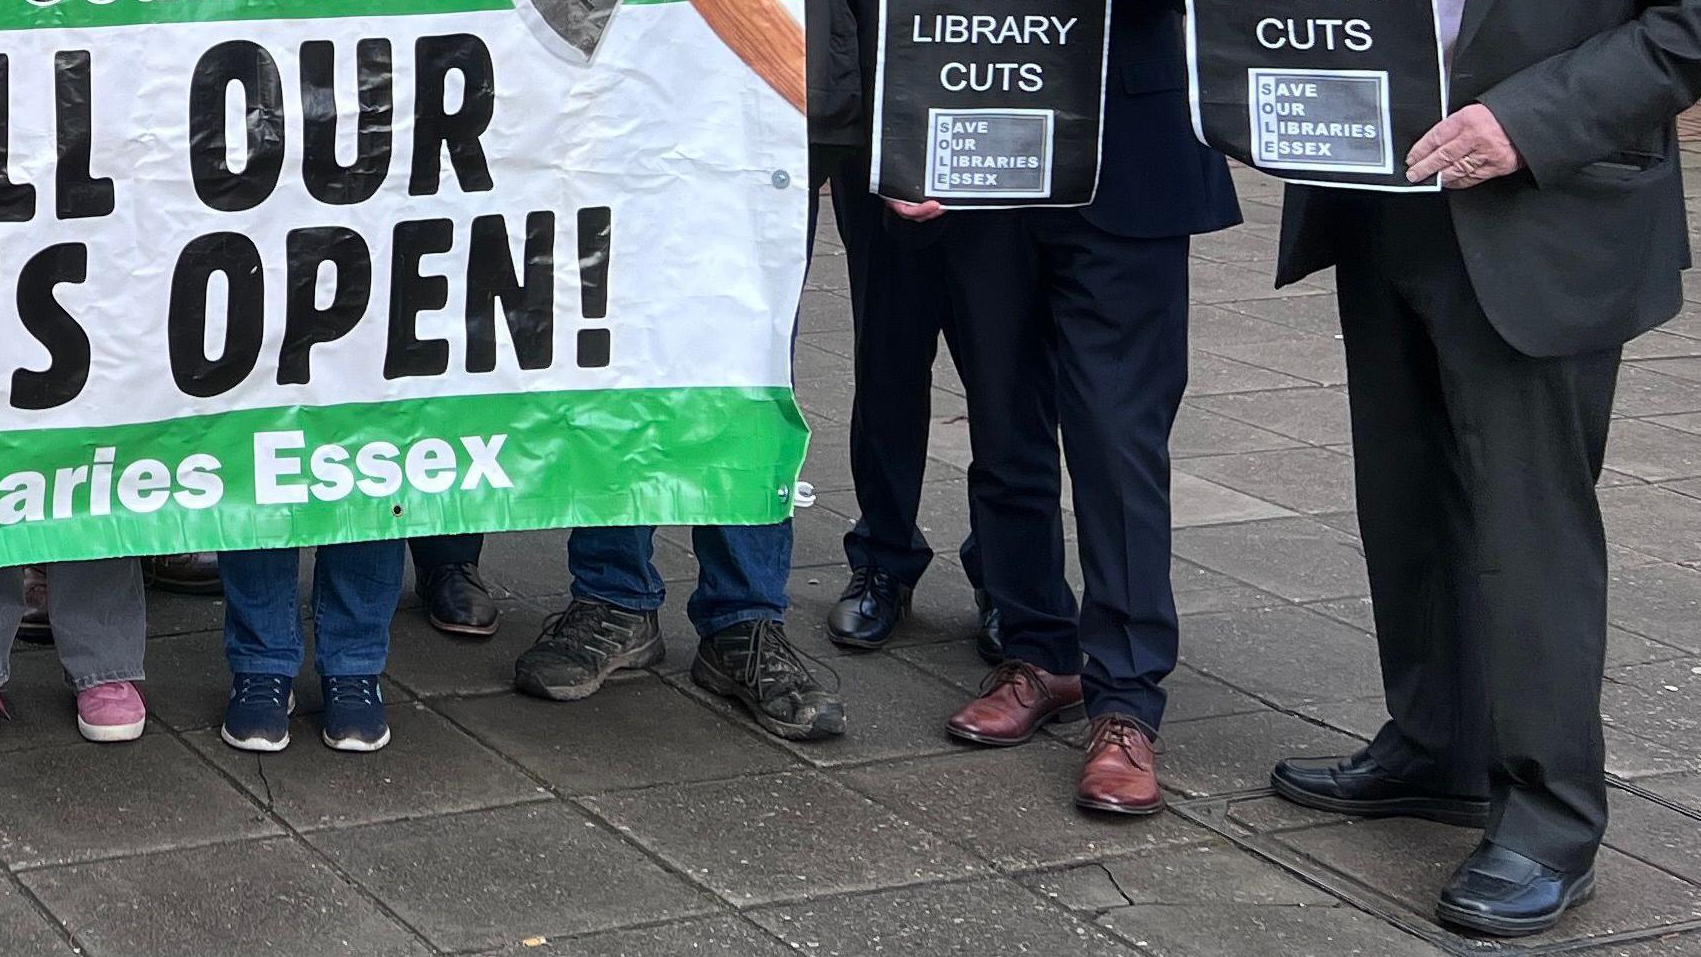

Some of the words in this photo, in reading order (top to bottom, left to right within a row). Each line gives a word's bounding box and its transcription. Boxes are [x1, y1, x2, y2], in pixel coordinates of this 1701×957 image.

[912, 14, 1078, 45] LIBRARY
[1256, 17, 1373, 51] CUTS
[939, 62, 1044, 92] CUTS
[1261, 83, 1318, 98] SAVE
[1262, 102, 1306, 117] OUR
[188, 32, 496, 213] OUR
[939, 121, 989, 134] SAVE
[1264, 122, 1376, 138] LIBRARIES
[939, 138, 977, 151] OUR
[1264, 141, 1332, 156] ESSEX
[939, 155, 1040, 168] LIBRARIES
[937, 173, 998, 186] ESSEX
[167, 206, 612, 399] OPEN!
[252, 430, 514, 506] Essex
